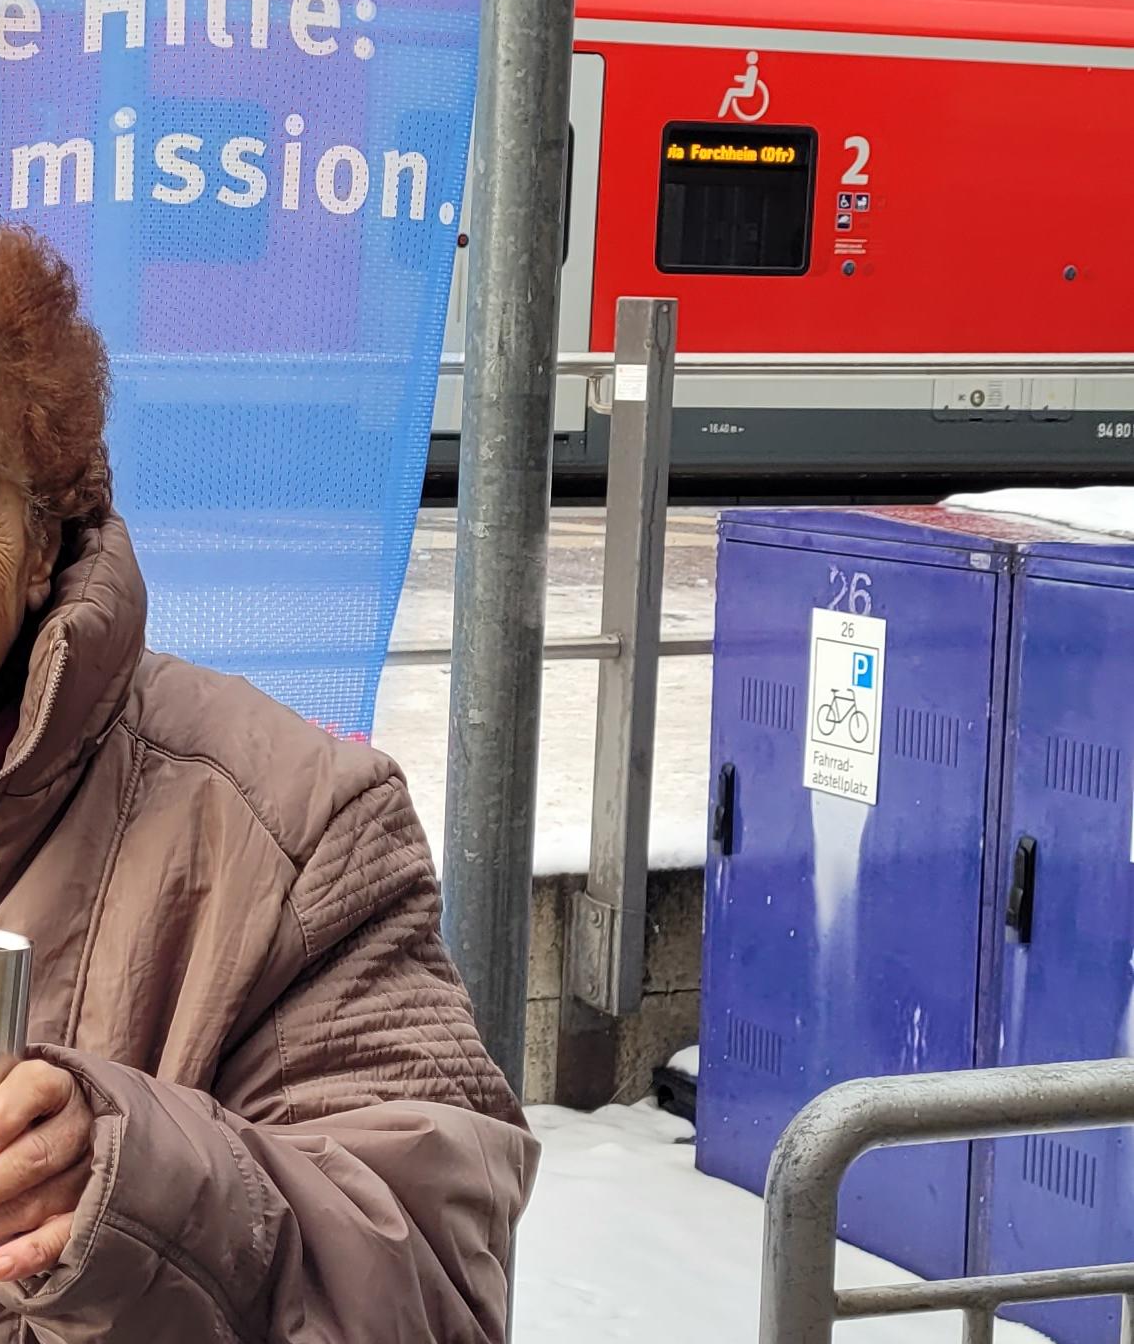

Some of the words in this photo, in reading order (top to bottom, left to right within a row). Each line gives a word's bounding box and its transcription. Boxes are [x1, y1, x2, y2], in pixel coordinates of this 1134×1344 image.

[690, 144, 758, 161] Forchheim
[841, 136, 870, 185] 2
[829, 565, 872, 615] 26
[841, 621, 855, 639] 26
[854, 655, 869, 685] P
[812, 750, 854, 771] Fahrrad-
[812, 770, 869, 797] abstellplatz
